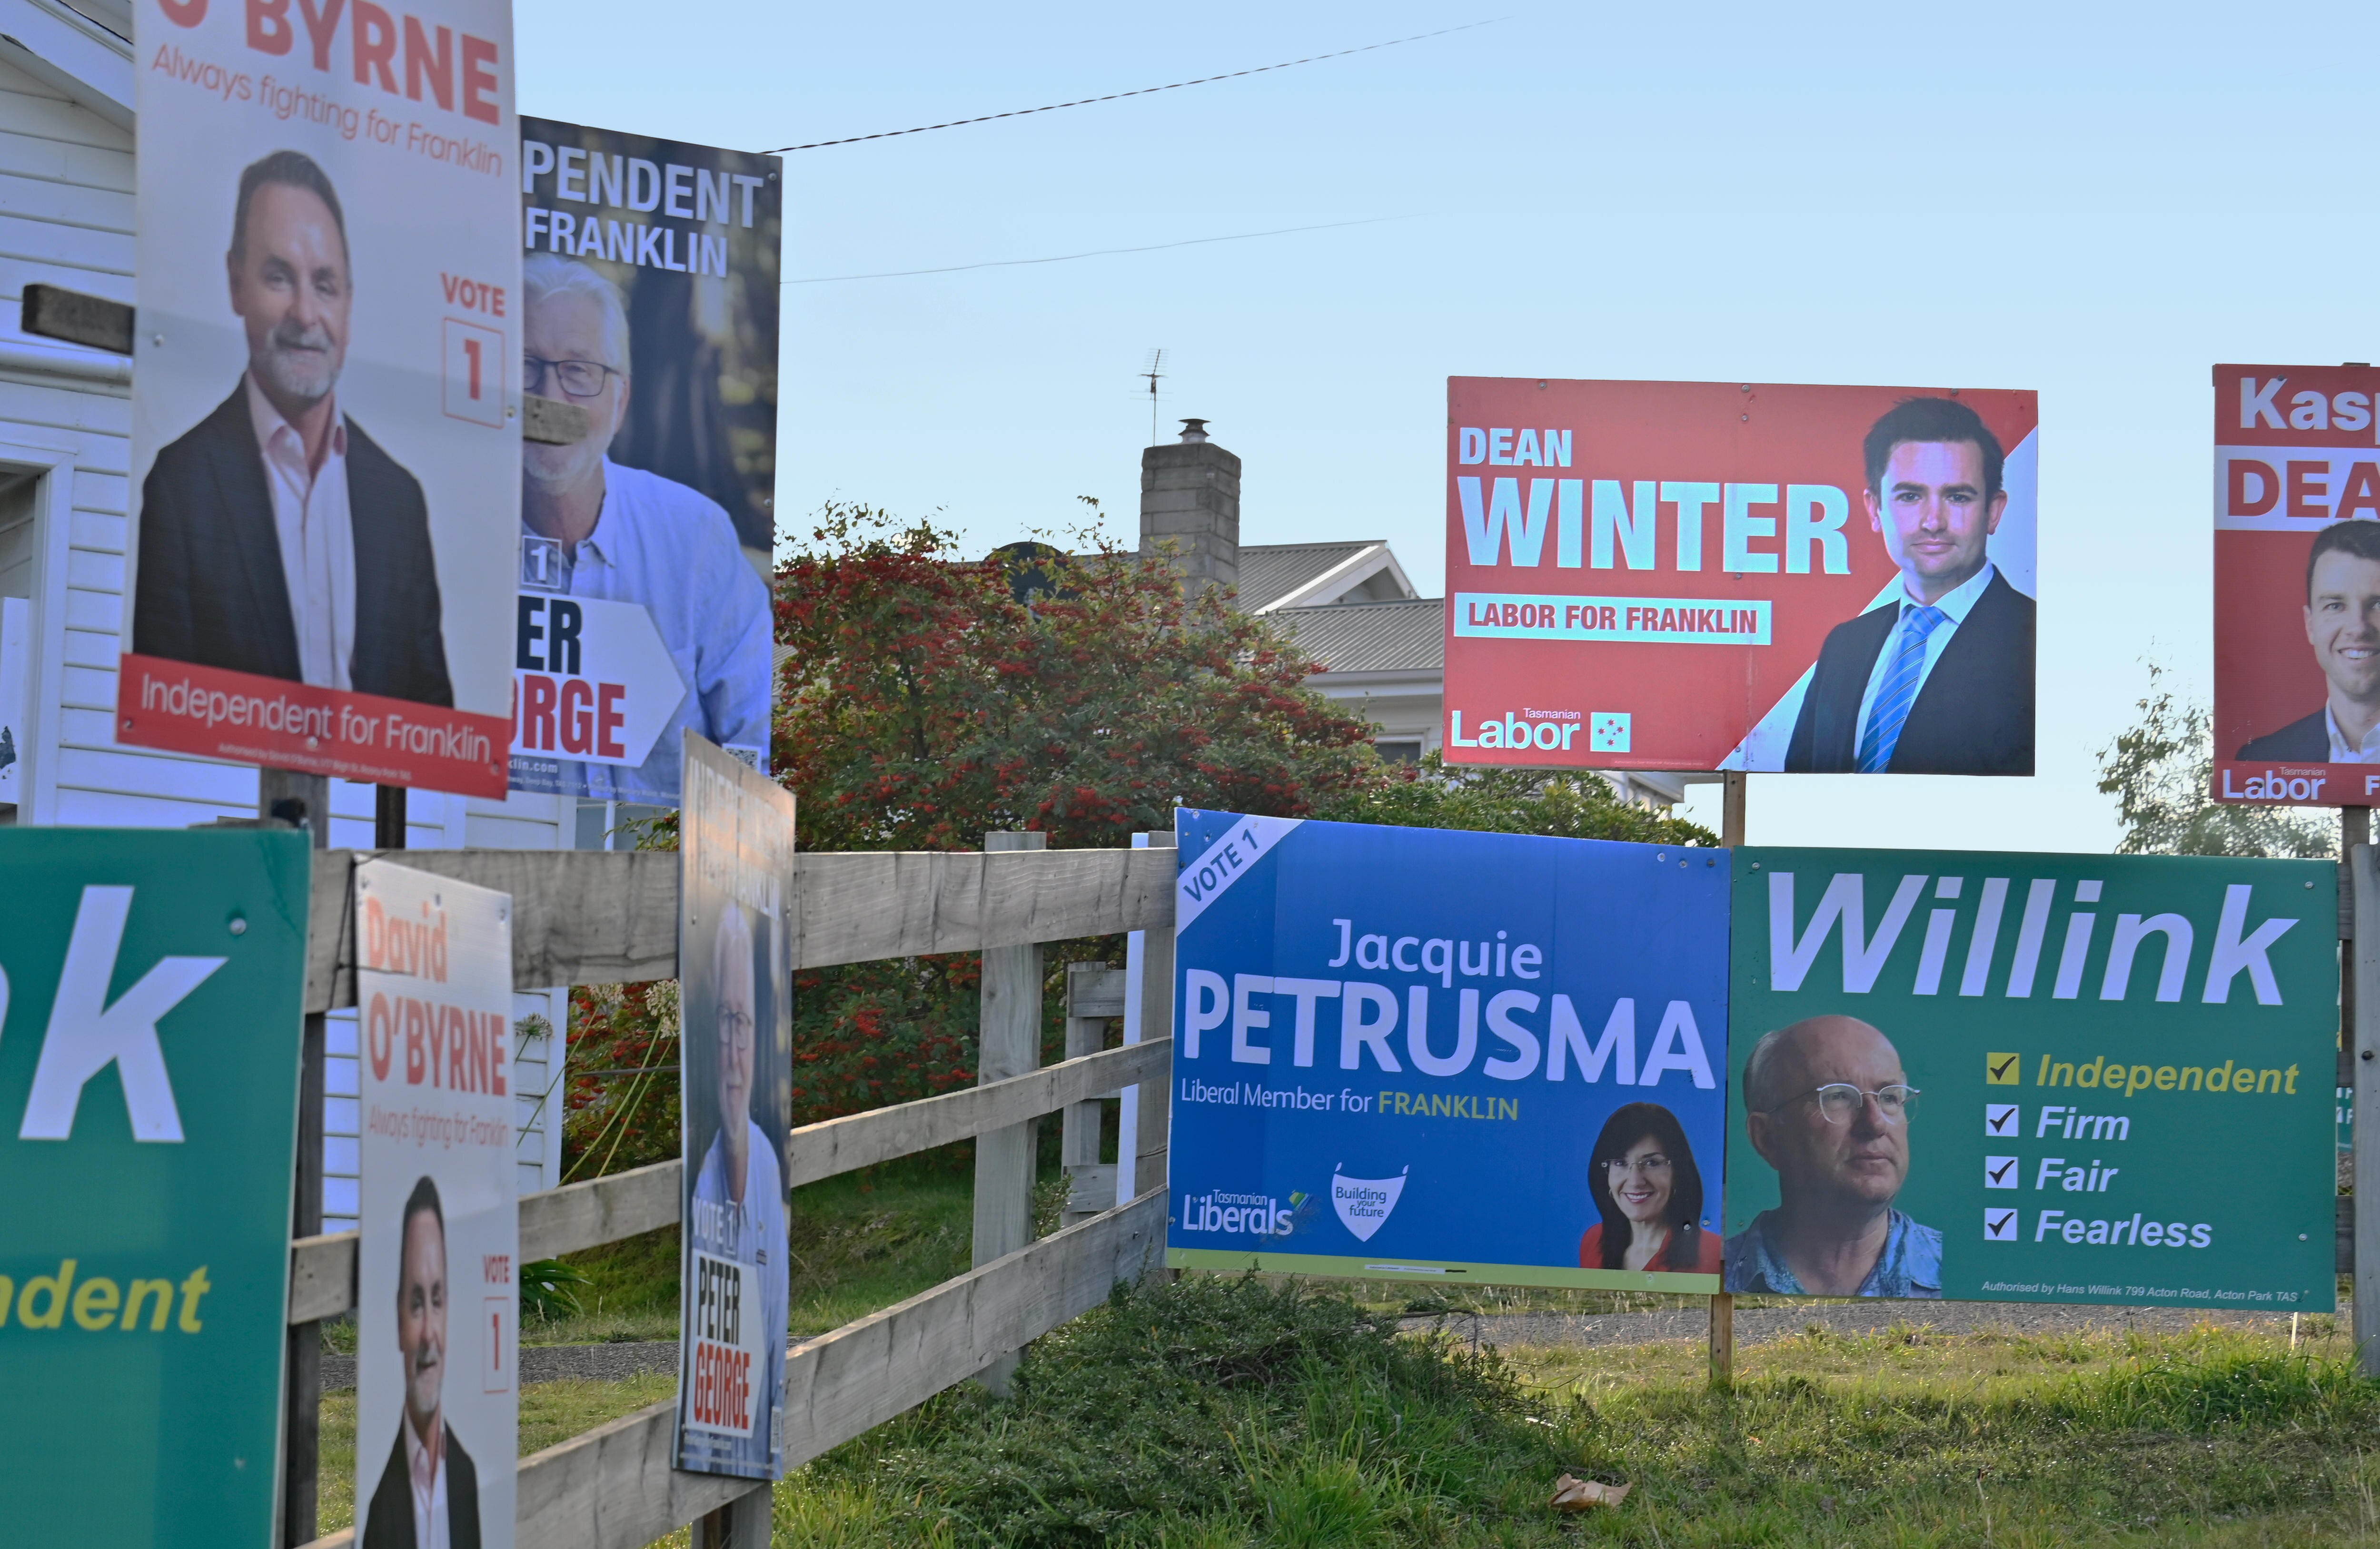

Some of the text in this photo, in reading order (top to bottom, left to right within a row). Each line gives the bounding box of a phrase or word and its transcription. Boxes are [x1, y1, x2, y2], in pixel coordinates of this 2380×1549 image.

[152, 44, 503, 177] Always fighting for Franklin
[523, 139, 764, 228] PENDENT
[525, 207, 728, 278] FRANKLIN
[441, 273, 506, 317] VOTE
[464, 338, 481, 401] 1
[2240, 376, 2380, 445] Kas
[1458, 426, 1573, 467] DEAN
[2228, 459, 2380, 519] DEA
[1457, 476, 1852, 575] WINTER
[531, 545, 548, 582] 1
[516, 595, 583, 675] ER
[1468, 601, 1758, 635] LABOR FOR FRANKLIN
[141, 673, 491, 765] Independent for Franklin
[1451, 710, 1581, 750] Labor
[1523, 708, 1581, 720] Tasmanian
[2222, 769, 2326, 800] Labor
[2279, 767, 2326, 776] Tasmanian
[1182, 828, 1259, 903] VOTE 1
[367, 896, 448, 983] David
[1328, 918, 1543, 988] Jacquie
[1767, 872, 2300, 1006] Willink
[0, 884, 229, 1144] k
[1183, 968, 1716, 1089] PETRUSMA
[368, 991, 506, 1096] O'BYRNE
[1181, 1077, 1518, 1121] Liberal Member for FRANKLIN
[2036, 1054, 2299, 1097] Independent
[368, 1103, 410, 1145] Always
[411, 1106, 453, 1151] fighting
[453, 1111, 470, 1142] for
[2035, 1106, 2130, 1141] Firm
[1212, 1189, 1268, 1206] Tasmanian
[1336, 1186, 1387, 1204] Building
[2035, 1158, 2119, 1193] Fair
[692, 1195, 734, 1248] VOTE 1
[1182, 1194, 1294, 1236] Liberals
[1349, 1205, 1384, 1218] future
[1357, 1199, 1376, 1208] your
[2034, 1209, 2212, 1249] Fearless
[483, 1254, 511, 1285] VOTE
[1982, 1281, 2299, 1302] Authorised by Hans Willink 799 Acton Road, Acton Park TAS
[0, 1259, 211, 1334] dent
[697, 1255, 741, 1346] PETER
[492, 1312, 500, 1371] 1
[694, 1341, 751, 1431] GEORGE
